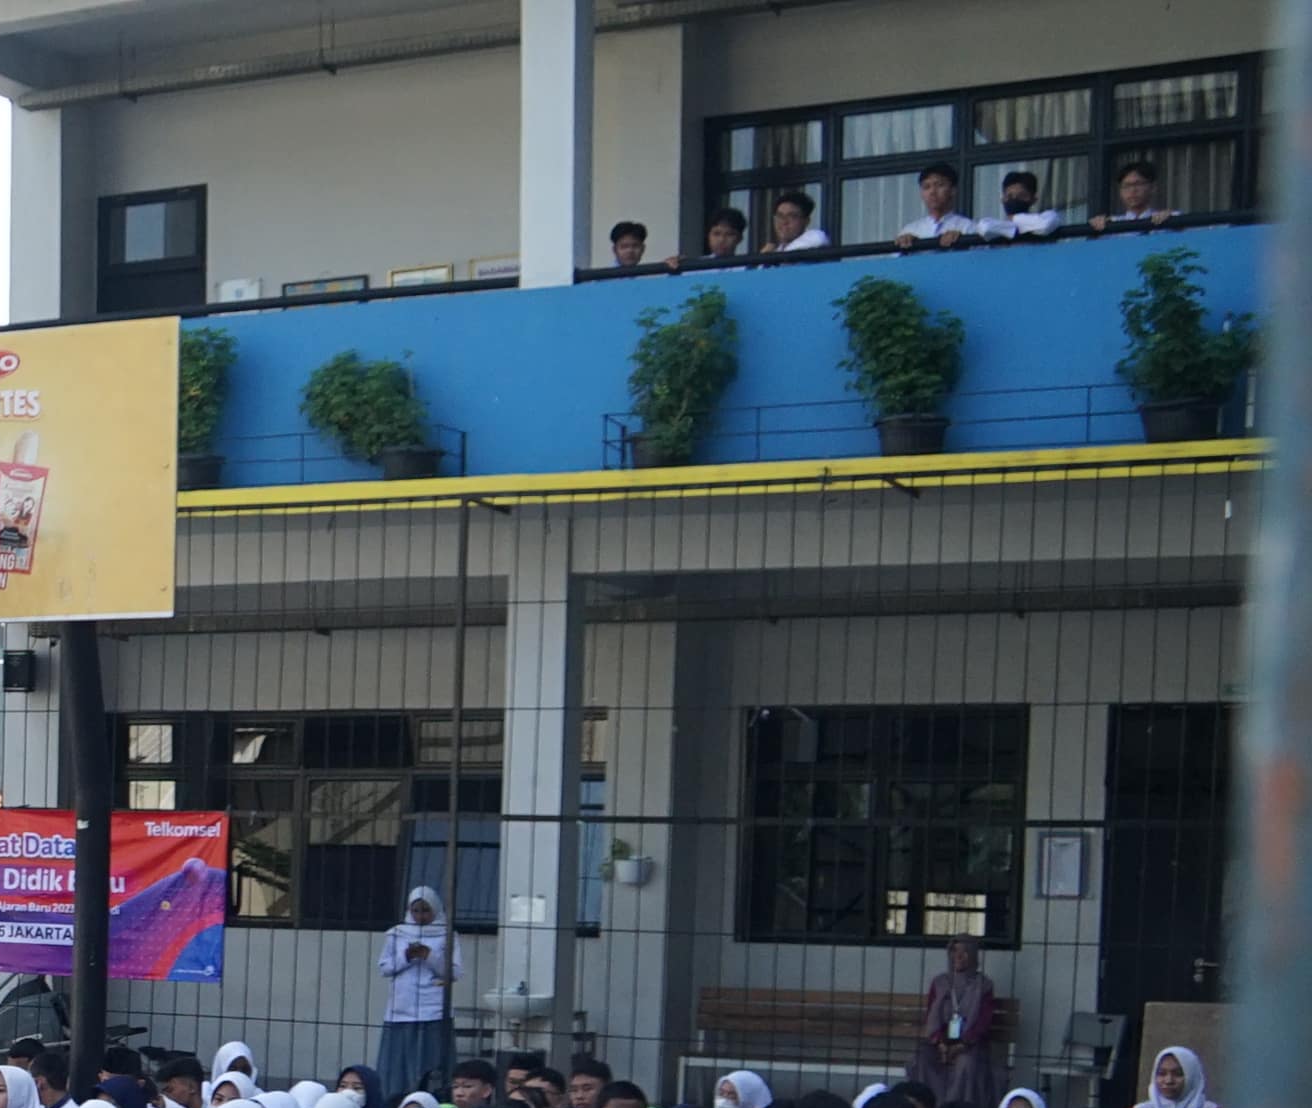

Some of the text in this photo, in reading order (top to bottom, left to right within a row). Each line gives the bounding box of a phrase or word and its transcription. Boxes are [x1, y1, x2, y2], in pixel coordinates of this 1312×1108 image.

[143, 820, 221, 838] Telkomsel
[24, 832, 76, 858] Data
[3, 867, 64, 892] Didik
[28, 902, 51, 912] Baru
[7, 925, 74, 940] JAKARTA
